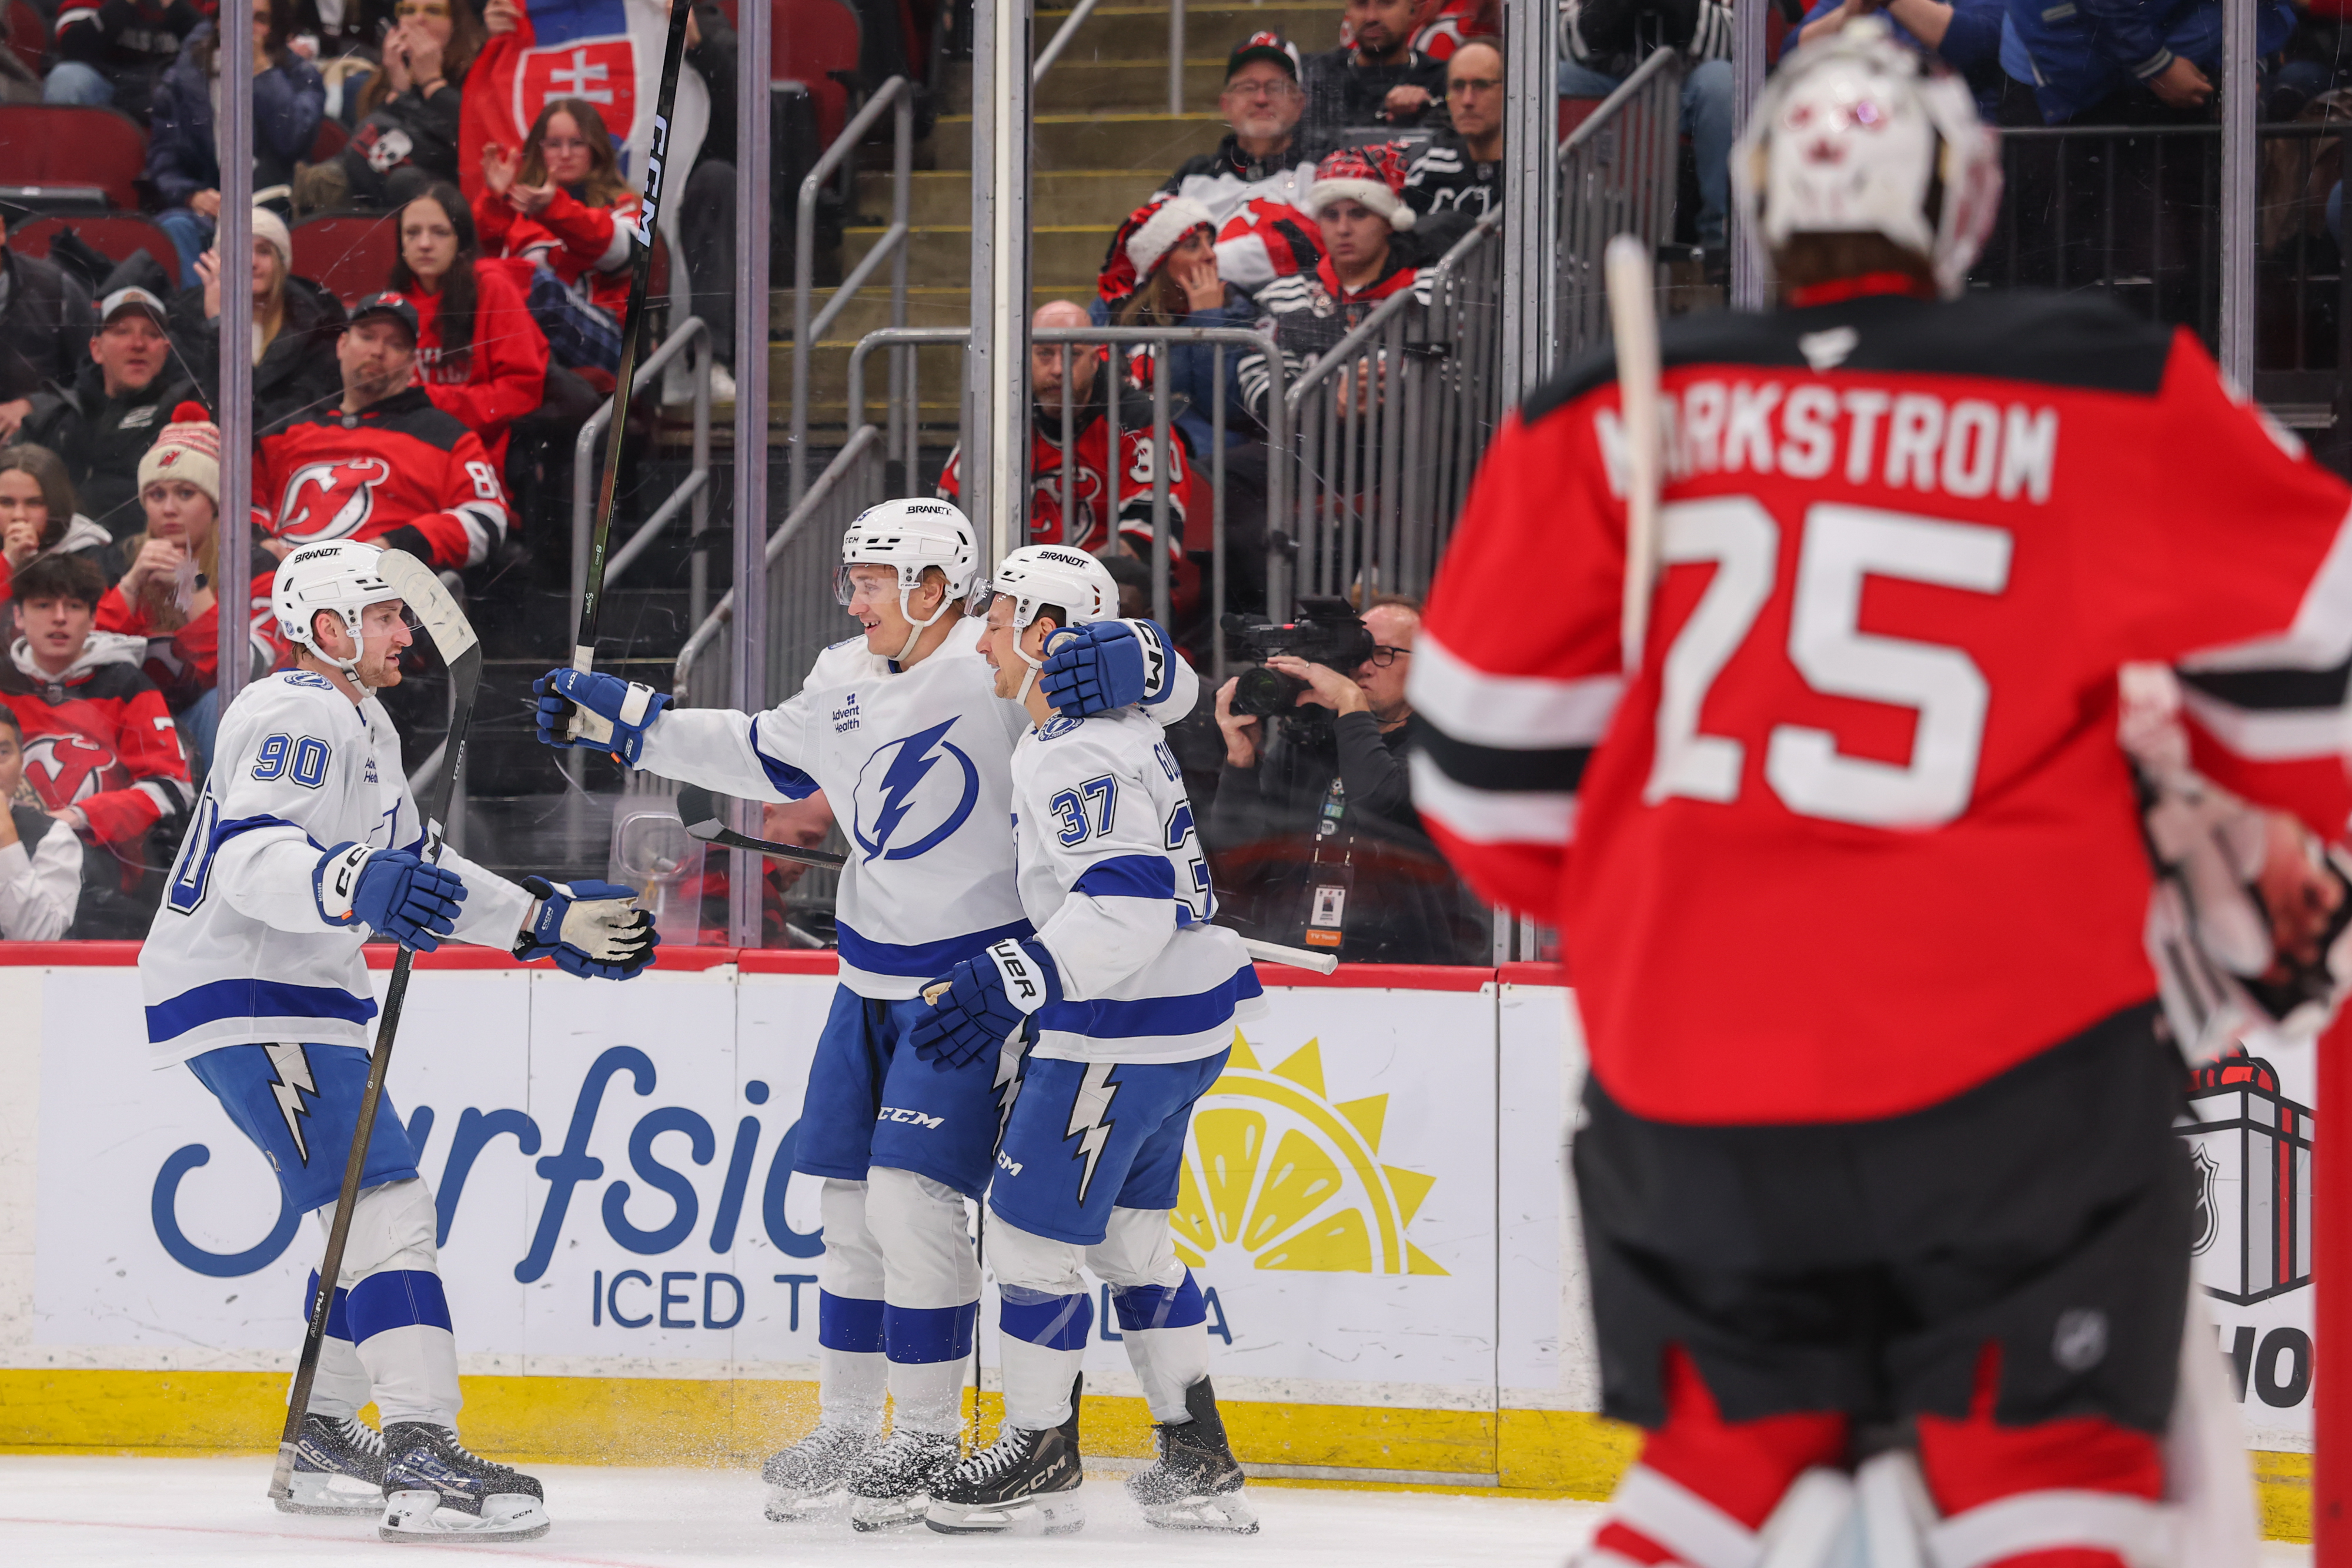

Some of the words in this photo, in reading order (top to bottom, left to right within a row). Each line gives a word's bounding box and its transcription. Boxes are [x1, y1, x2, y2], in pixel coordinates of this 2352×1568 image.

[637, 114, 668, 248] CCM
[906, 505, 949, 515] BRANDT
[293, 547, 342, 564] BRANDT
[1037, 551, 1089, 568] BRANDT
[1134, 621, 1164, 690] CM
[1644, 495, 2013, 830] 25
[833, 705, 860, 723] Advent
[834, 718, 860, 735] Health
[251, 733, 332, 790] 90
[453, 742, 465, 778] CCM
[626, 738, 636, 758] CCM
[1050, 773, 1118, 848] 37
[335, 845, 374, 898] CC
[541, 906, 552, 931] CCM
[991, 938, 1037, 999] UER
[877, 1106, 946, 1130] CCM
[997, 1148, 1024, 1178] CM
[593, 1269, 745, 1329] ICED
[299, 1439, 342, 1470] CCM
[1013, 1454, 1067, 1499] CCM
[512, 1509, 533, 1519] CCM
